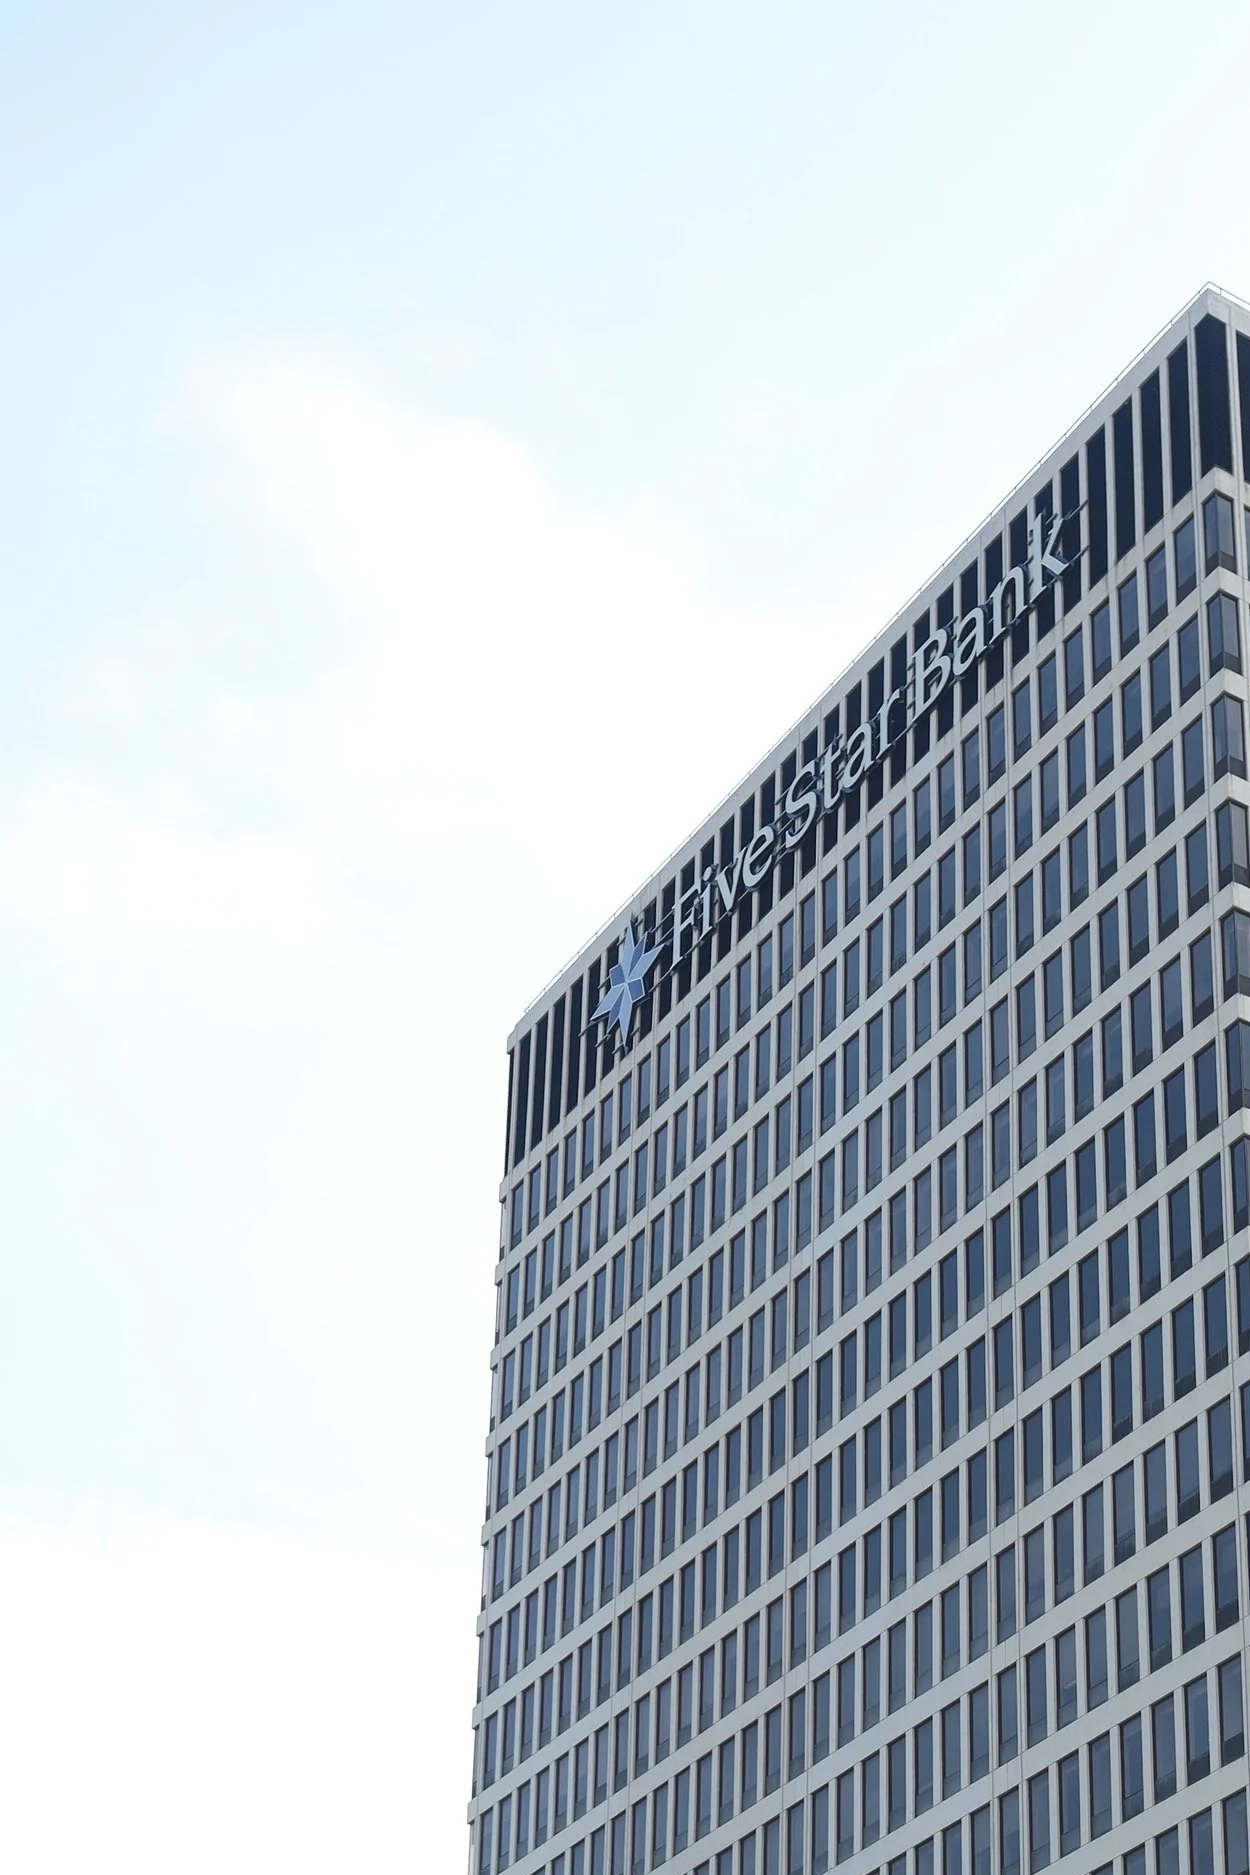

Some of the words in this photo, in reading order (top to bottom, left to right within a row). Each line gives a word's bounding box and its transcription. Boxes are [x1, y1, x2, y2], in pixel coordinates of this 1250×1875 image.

[670, 825, 776, 971] Five
[785, 687, 901, 849] Star
[911, 512, 1070, 723] Bank
